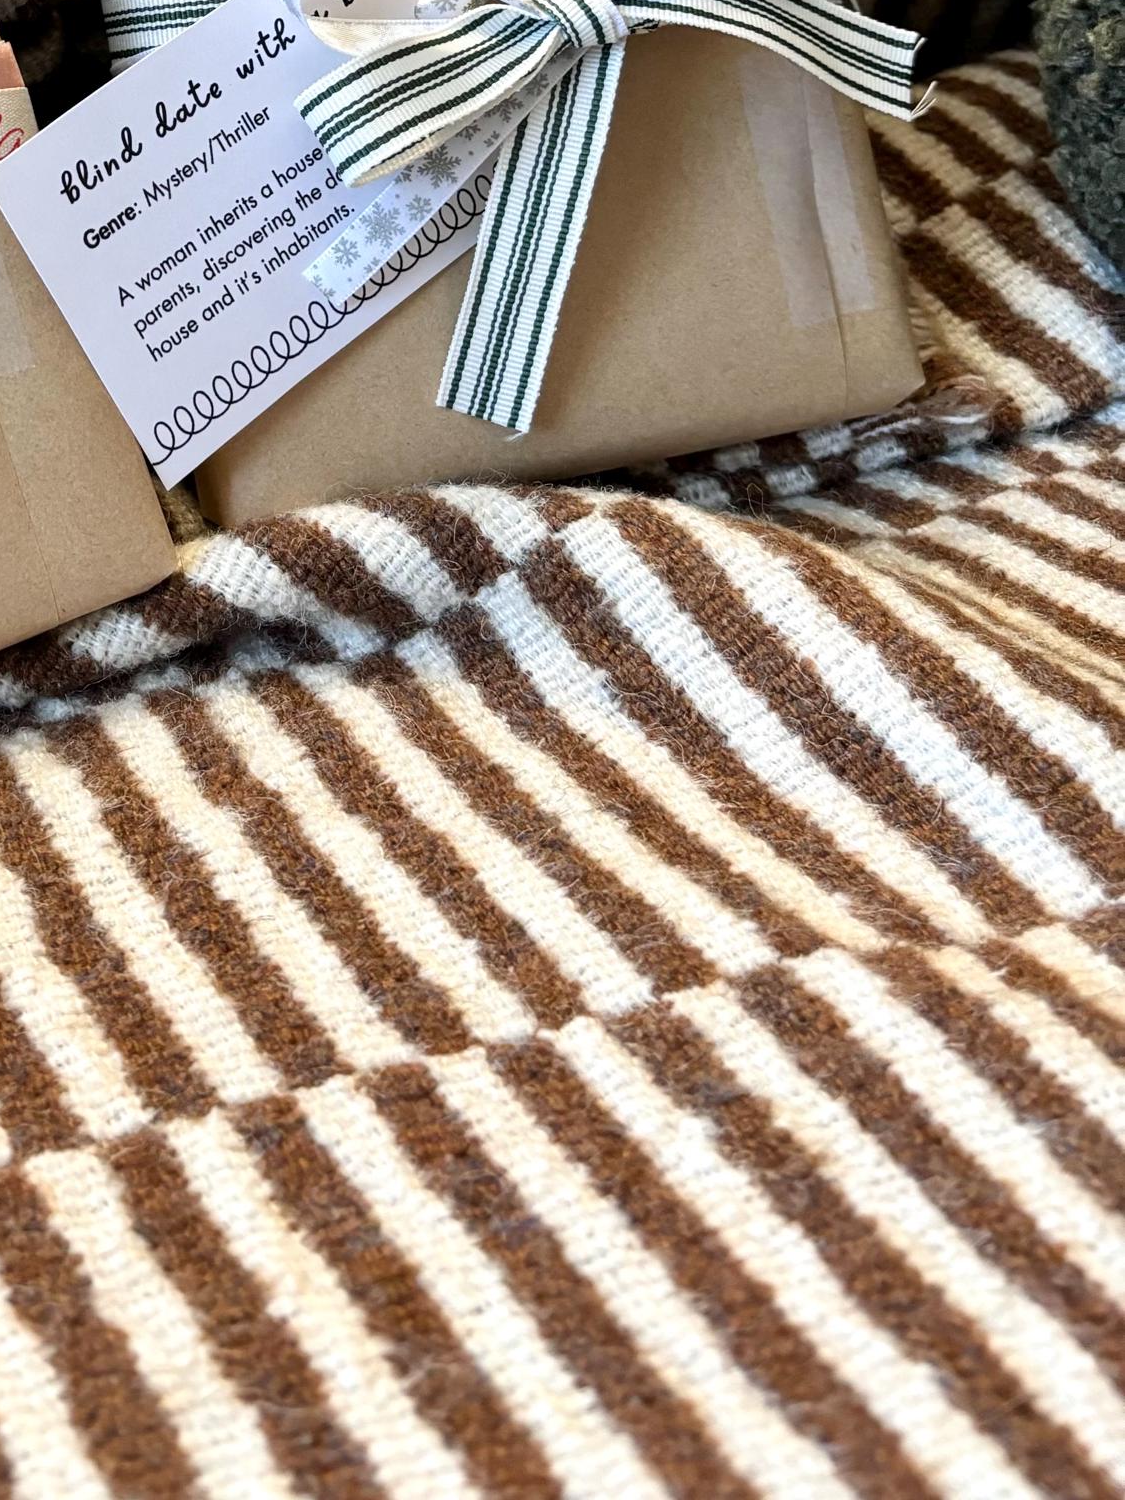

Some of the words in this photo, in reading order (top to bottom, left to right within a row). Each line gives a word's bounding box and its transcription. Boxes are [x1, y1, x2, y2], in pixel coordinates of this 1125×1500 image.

[59, 126, 143, 205] blind
[155, 79, 223, 139] date
[235, 17, 296, 80] with
[82, 202, 142, 250] Genre:
[142, 106, 270, 208] Mystery/Thriller
[118, 285, 135, 308] A
[134, 241, 198, 292] woman
[196, 195, 258, 245] inherits
[260, 183, 274, 199] a
[271, 147, 324, 188] house
[133, 282, 201, 340] parents,
[202, 207, 299, 281] discovering
[294, 187, 323, 212] the
[145, 319, 199, 363] house
[201, 284, 236, 322] and
[234, 270, 262, 296] it's
[260, 204, 356, 275] inhabitants.
